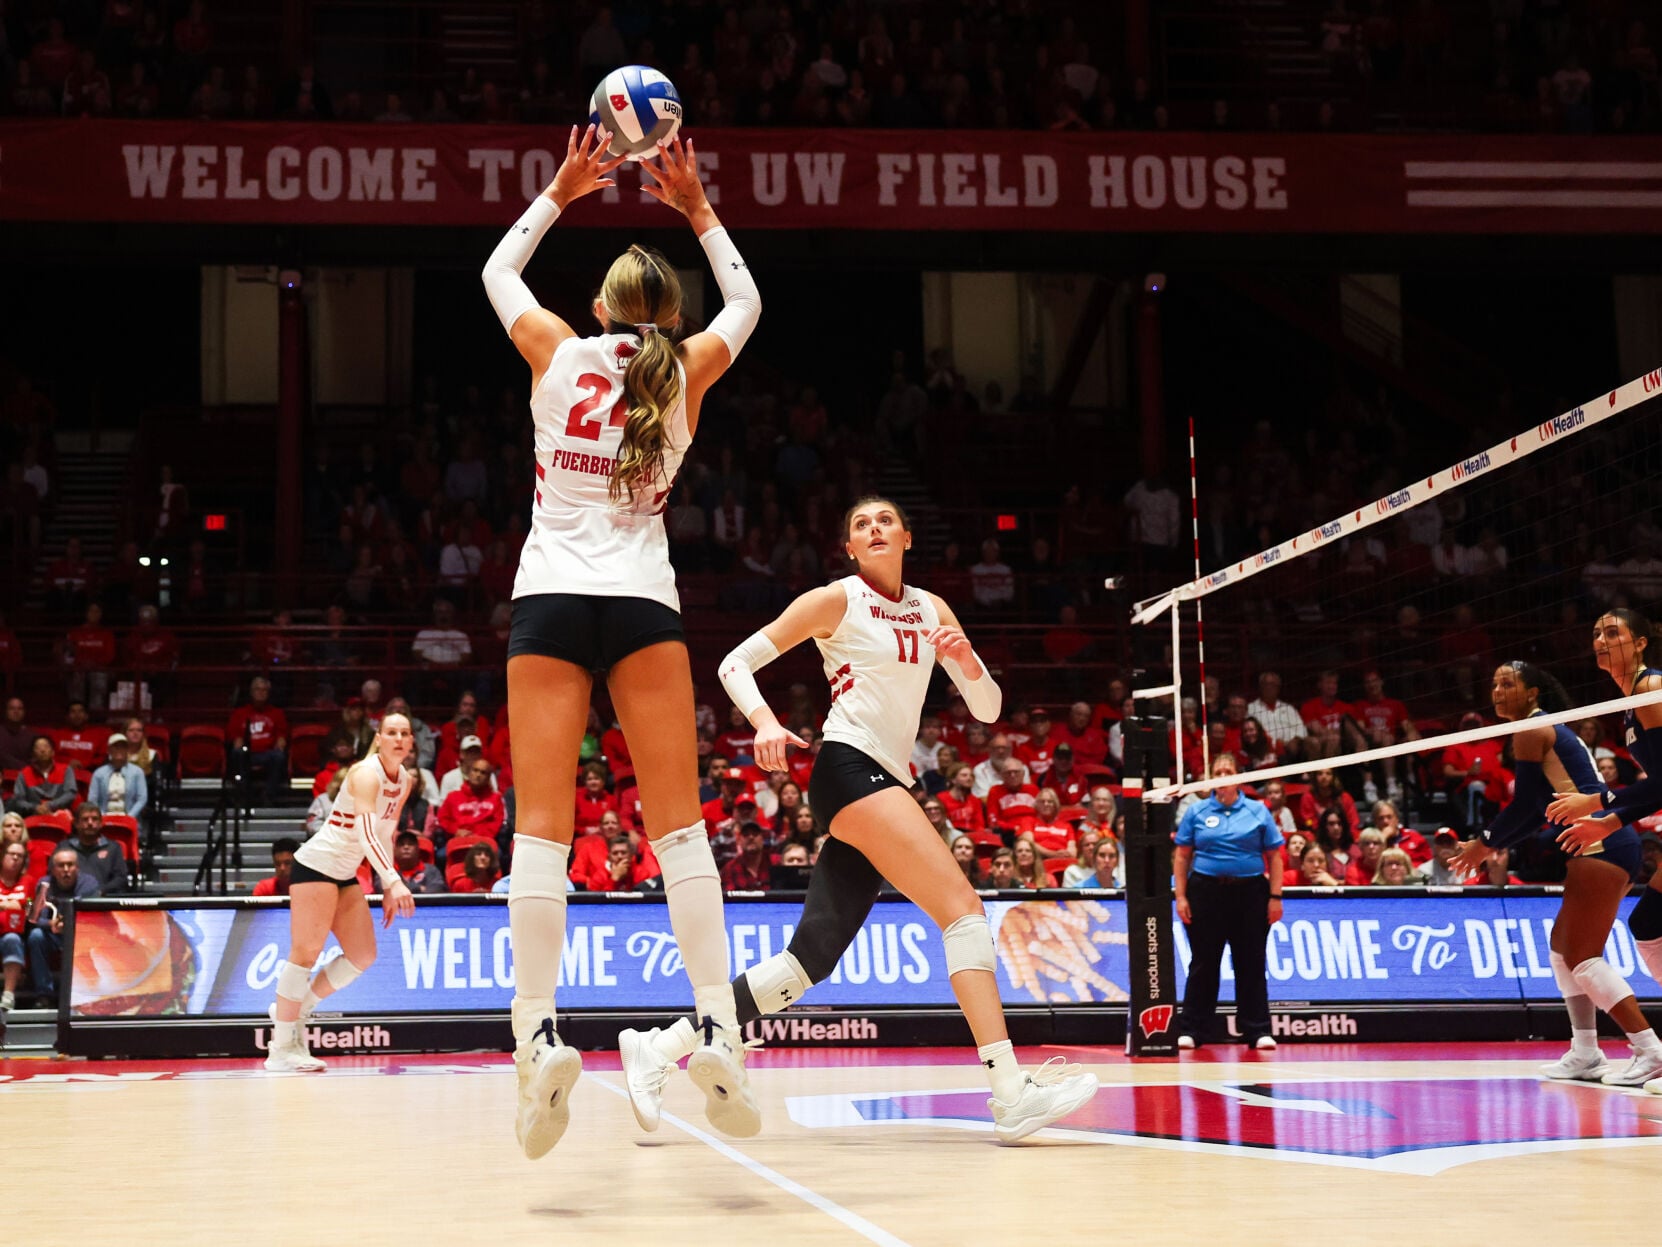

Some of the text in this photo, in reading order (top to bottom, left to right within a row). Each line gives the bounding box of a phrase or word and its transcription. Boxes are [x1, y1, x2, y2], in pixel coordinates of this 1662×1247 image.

[122, 145, 1288, 211] WELCOME TO TE UW FIELD HOUSE
[1538, 406, 1585, 442] UWHealth
[1451, 452, 1490, 481] UWHealth
[1376, 489, 1411, 515] UWHealth
[893, 627, 919, 665] 17
[399, 926, 617, 989] WELCME
[626, 931, 686, 983] To
[1146, 916, 1161, 1000] sports imports
[1172, 919, 1388, 981] COME
[1391, 922, 1457, 976] To
[254, 1025, 390, 1051] UHealth
[745, 1018, 878, 1041] UWHealth
[1139, 1005, 1174, 1039] W
[1226, 1014, 1358, 1037] UHealth
